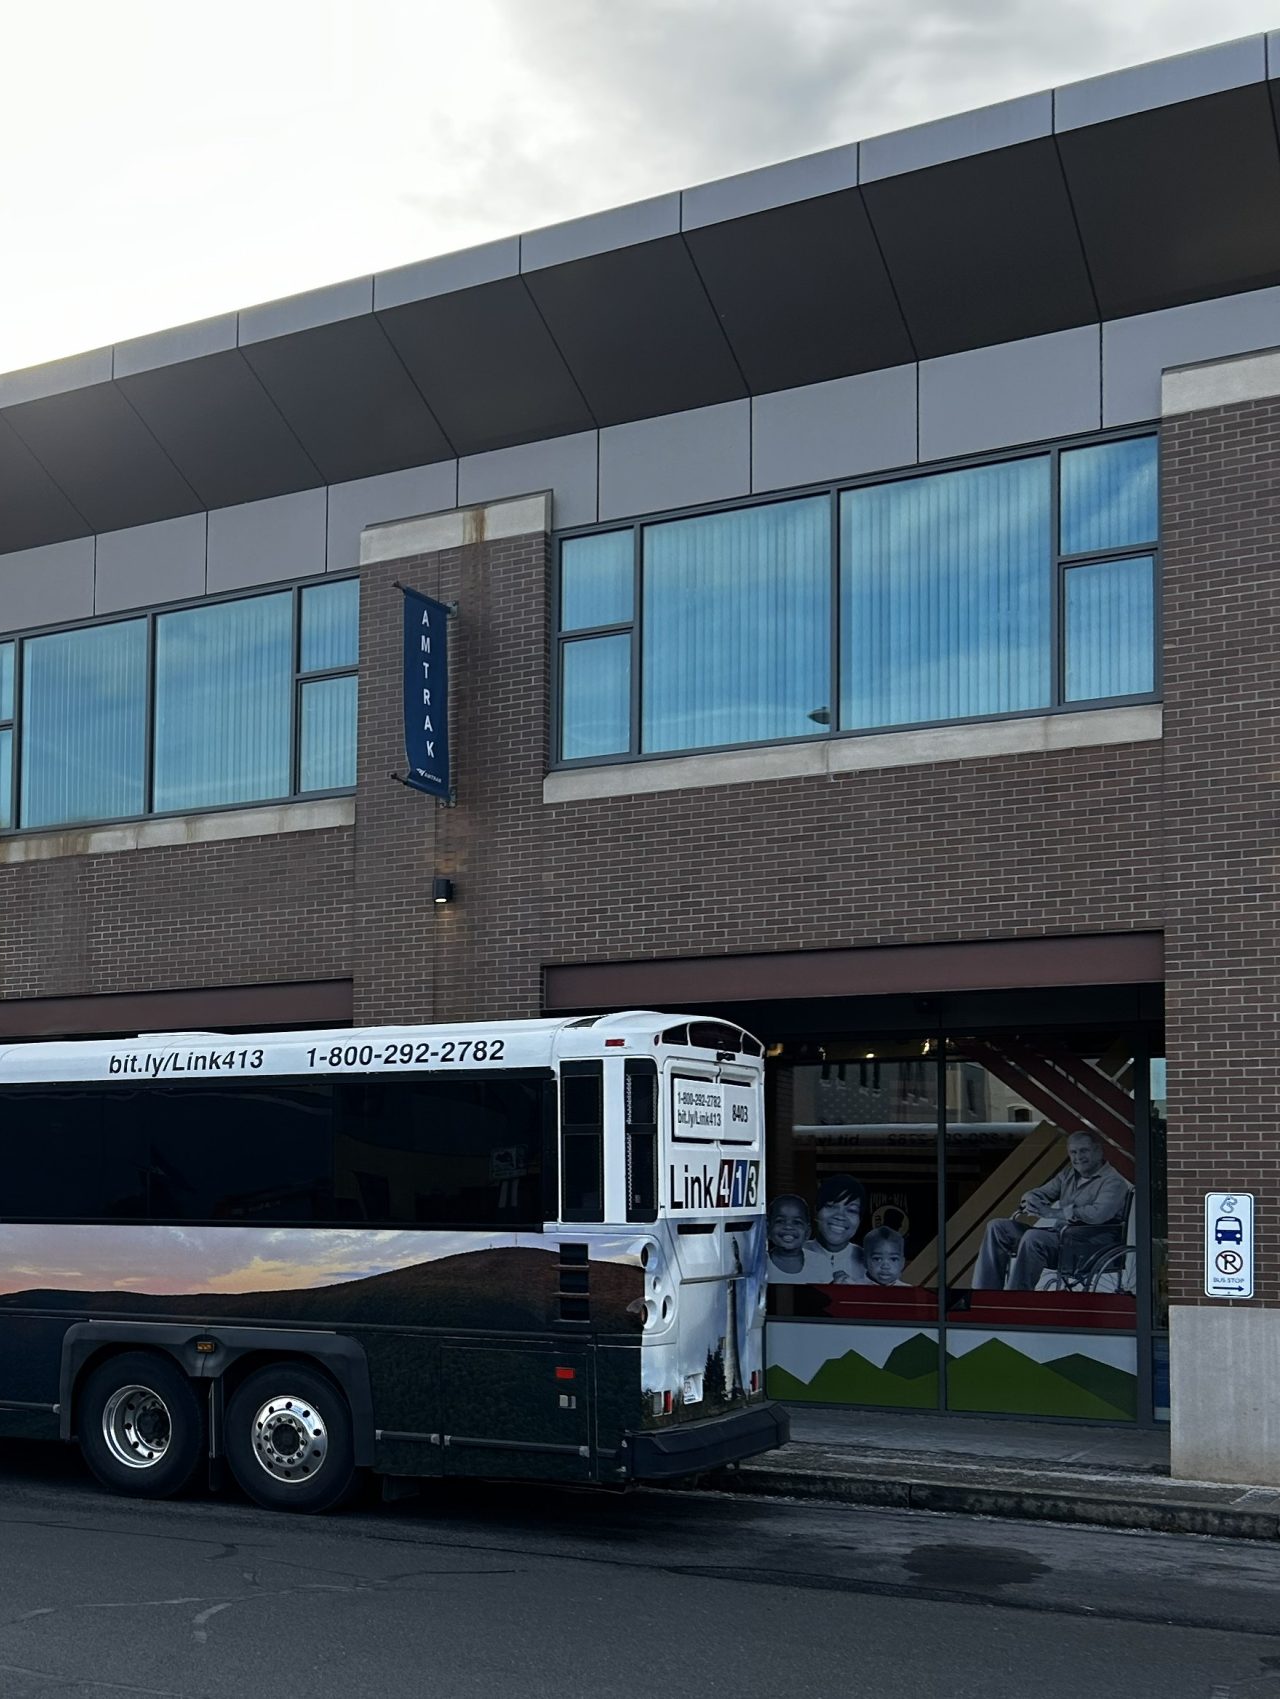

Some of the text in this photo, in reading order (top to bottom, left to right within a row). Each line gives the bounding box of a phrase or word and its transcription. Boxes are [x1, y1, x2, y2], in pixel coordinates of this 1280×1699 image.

[421, 609, 435, 758] AMTRAK
[109, 1049, 264, 1077] bit.ly/Link413
[306, 1040, 505, 1068] 1-800-292-2782
[677, 1092, 721, 1108] 1-800-292-2782
[677, 1109, 721, 1128] bit.ly/Link413
[732, 1104, 748, 1122] 8403
